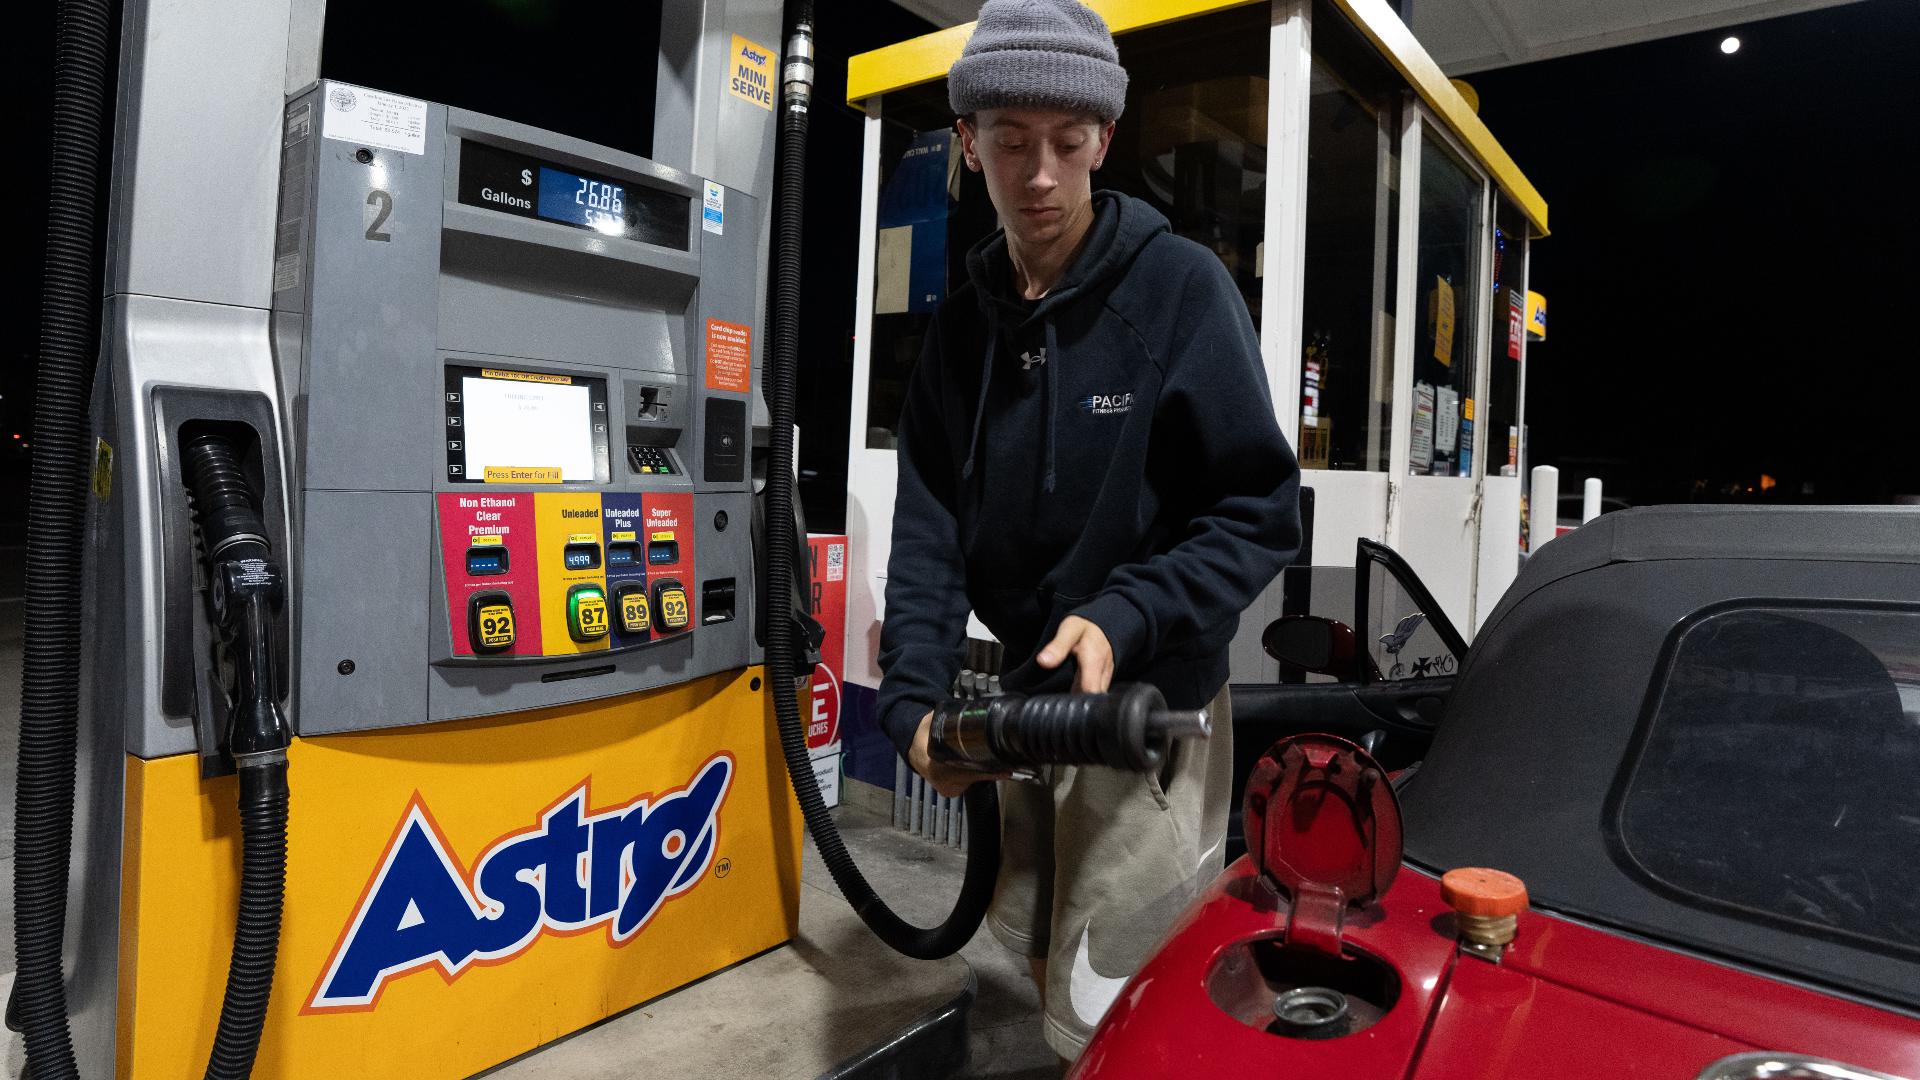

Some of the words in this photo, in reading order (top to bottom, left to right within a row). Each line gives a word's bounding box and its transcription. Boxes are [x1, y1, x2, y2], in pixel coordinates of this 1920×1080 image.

[741, 46, 766, 65] Astro
[738, 64, 766, 88] MINI
[732, 78, 771, 105] SERVE
[521, 168, 532, 187] $
[481, 187, 532, 210] Gallons
[576, 178, 624, 214] 26.86
[365, 190, 393, 243] 2
[710, 324, 723, 332] Card
[487, 470, 509, 479] Press
[511, 471, 532, 479] Enter
[534, 471, 545, 479] for
[459, 498, 478, 508] Non
[481, 497, 516, 508] Ethanol
[476, 511, 502, 521] Clear
[562, 509, 599, 519] Unleaded
[605, 508, 640, 518] Unleaded
[651, 508, 671, 518] Super
[468, 525, 510, 535] Premium
[615, 519, 632, 528] Plus
[646, 519, 678, 528] Unleaded
[581, 607, 605, 625] 87
[625, 604, 647, 621] 89
[665, 600, 685, 617] 92
[483, 616, 511, 636] 92
[808, 721, 828, 737] UCHES
[716, 862, 730, 874] TM
[305, 752, 734, 1011] Astro
